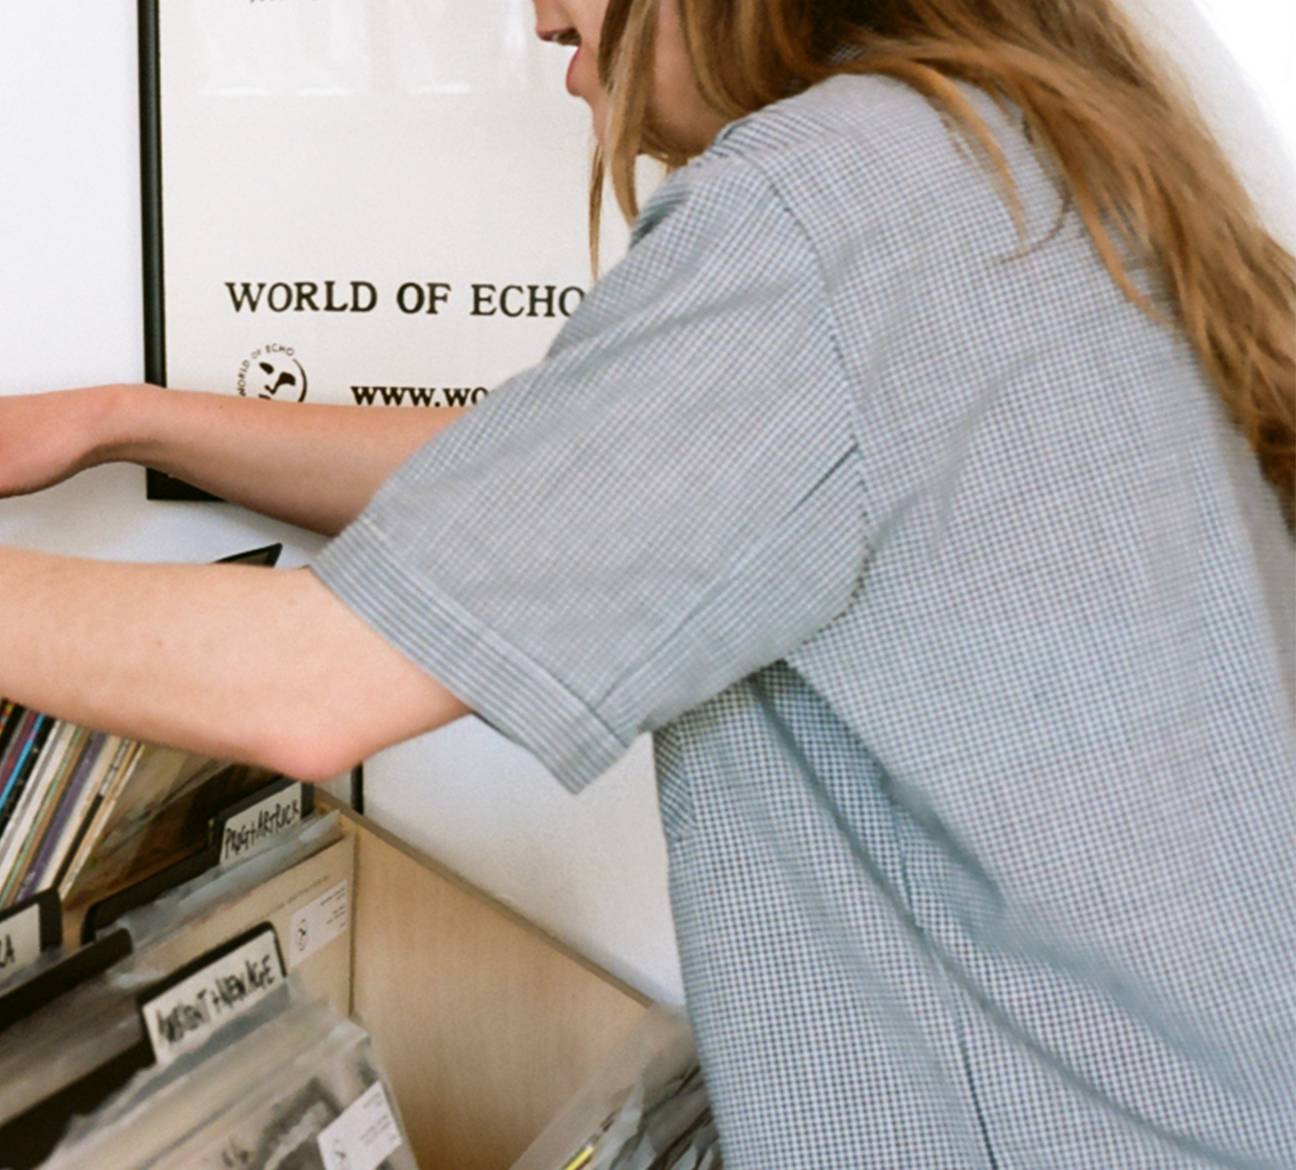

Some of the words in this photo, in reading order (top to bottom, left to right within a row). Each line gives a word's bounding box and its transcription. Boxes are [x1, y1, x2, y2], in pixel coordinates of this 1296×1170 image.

[225, 280, 378, 313] WORLD
[395, 282, 452, 315] OF
[469, 283, 587, 318] ECHO
[265, 342, 295, 357] ECHO
